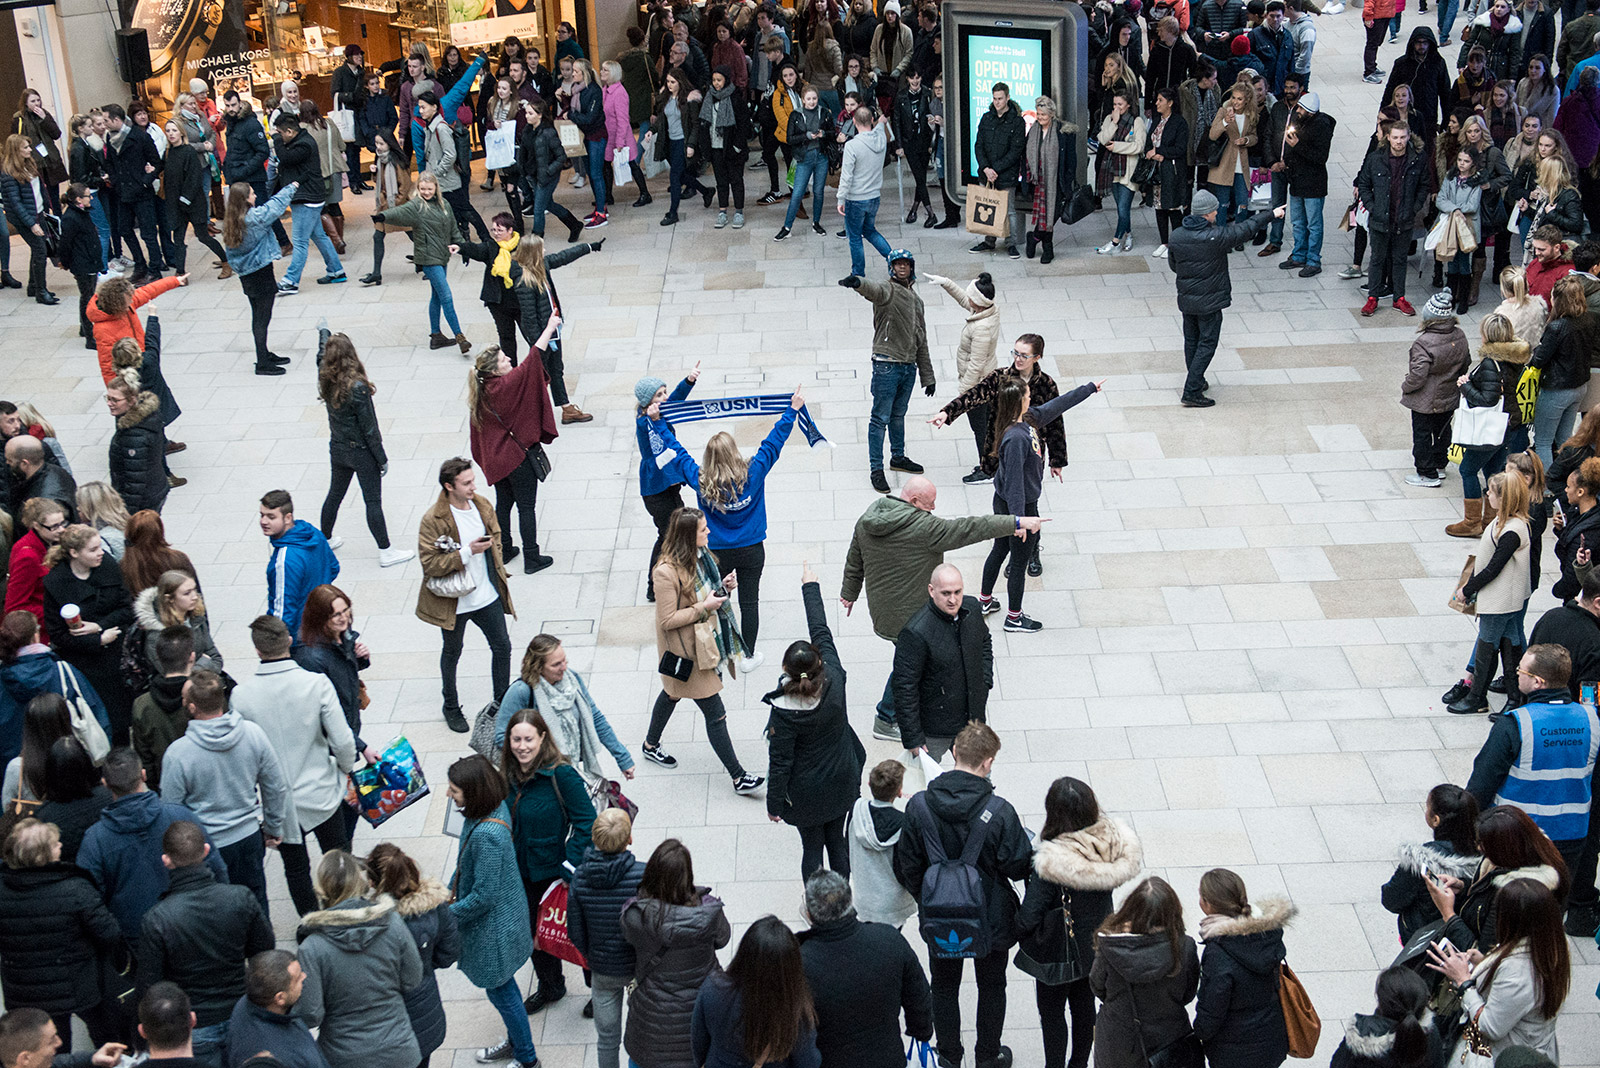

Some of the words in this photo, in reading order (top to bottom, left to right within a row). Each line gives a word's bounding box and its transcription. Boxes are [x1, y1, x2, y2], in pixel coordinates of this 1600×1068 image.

[186, 54, 237, 70] MICHAEL
[240, 48, 271, 62] KORS
[208, 63, 254, 80] ACCESS
[975, 60, 1008, 79] OPEN
[1012, 62, 1035, 81] DAY
[975, 79, 993, 93] SAT
[1015, 82, 1036, 96] NOV
[719, 397, 760, 412] USN
[1540, 727, 1585, 736] Customer
[1543, 738, 1583, 748] Services
[539, 925, 568, 939] DEBEN
[937, 951, 977, 959] adidas
